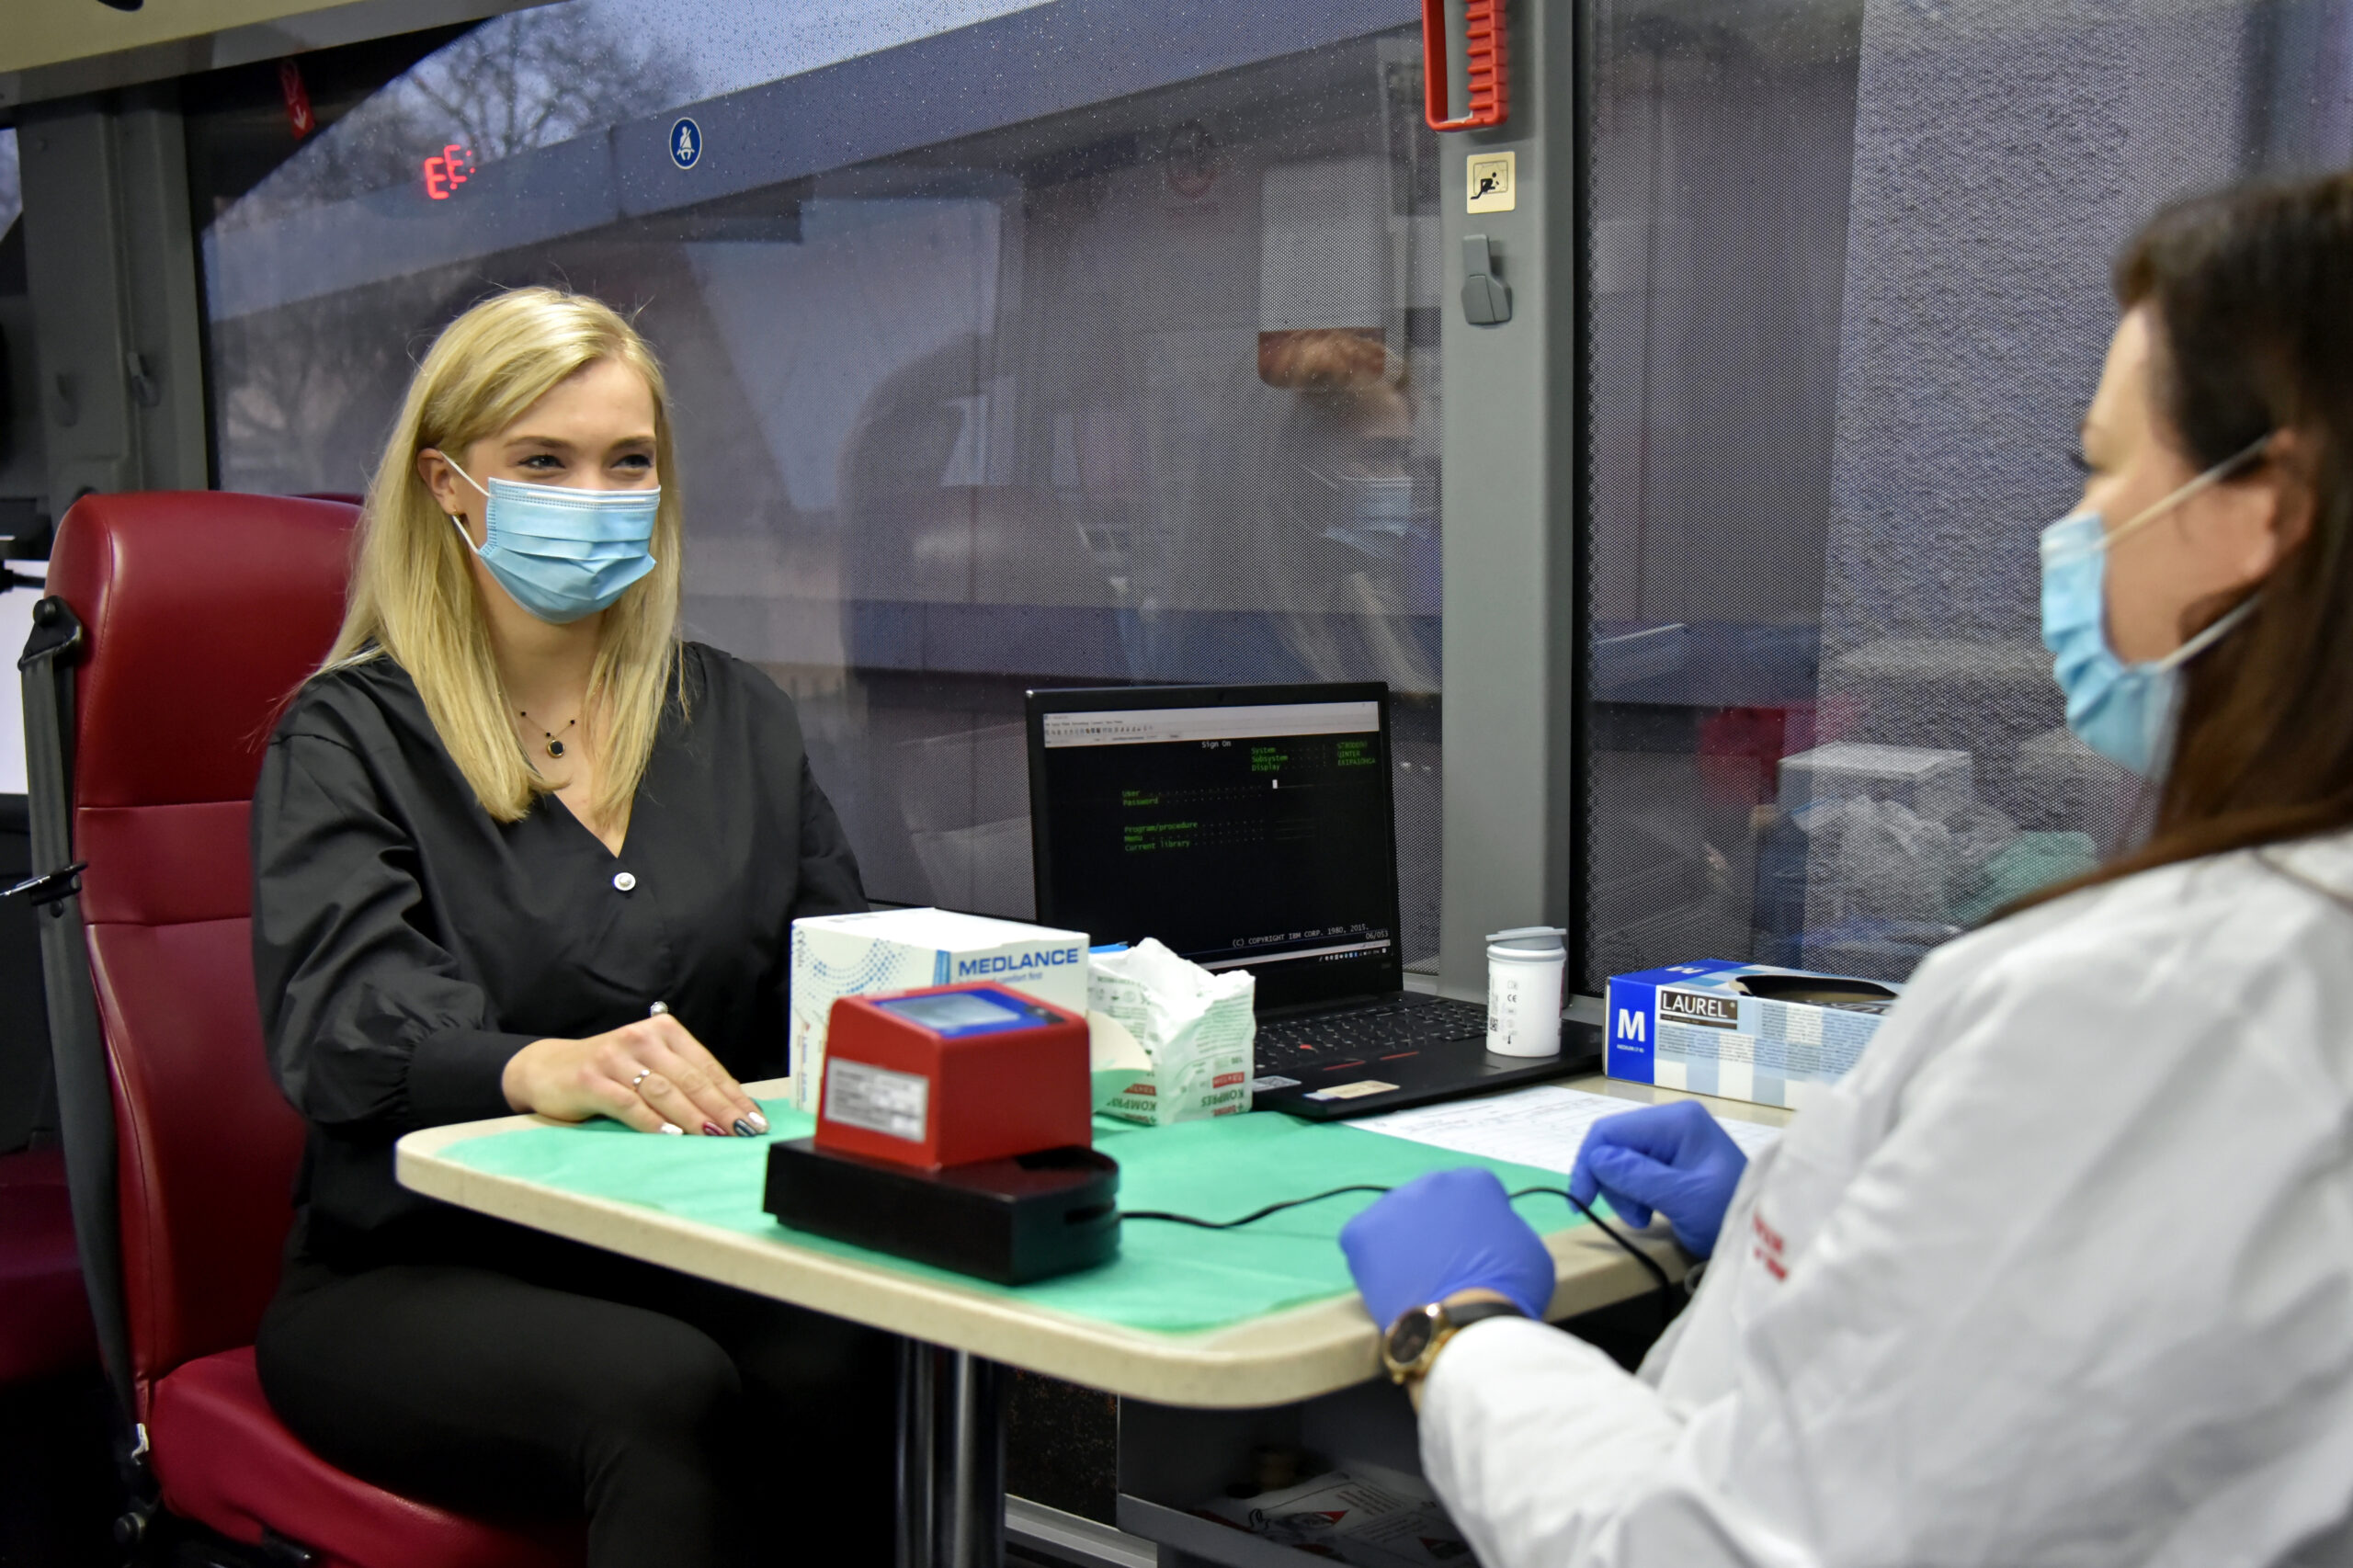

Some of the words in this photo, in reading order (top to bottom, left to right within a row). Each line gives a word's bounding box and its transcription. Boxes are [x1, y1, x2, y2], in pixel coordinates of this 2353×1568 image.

[1201, 741, 1219, 750] Sign
[1251, 763, 1280, 772] Display
[1123, 797, 1158, 806] Password
[1125, 842, 1155, 851] Current
[1232, 938, 1245, 947] (C)
[1248, 933, 1285, 945] COPYRIGHT
[958, 948, 1079, 977] MEDLANCE
[1662, 993, 1728, 1018] LAUREL
[1617, 1007, 1646, 1042] M
